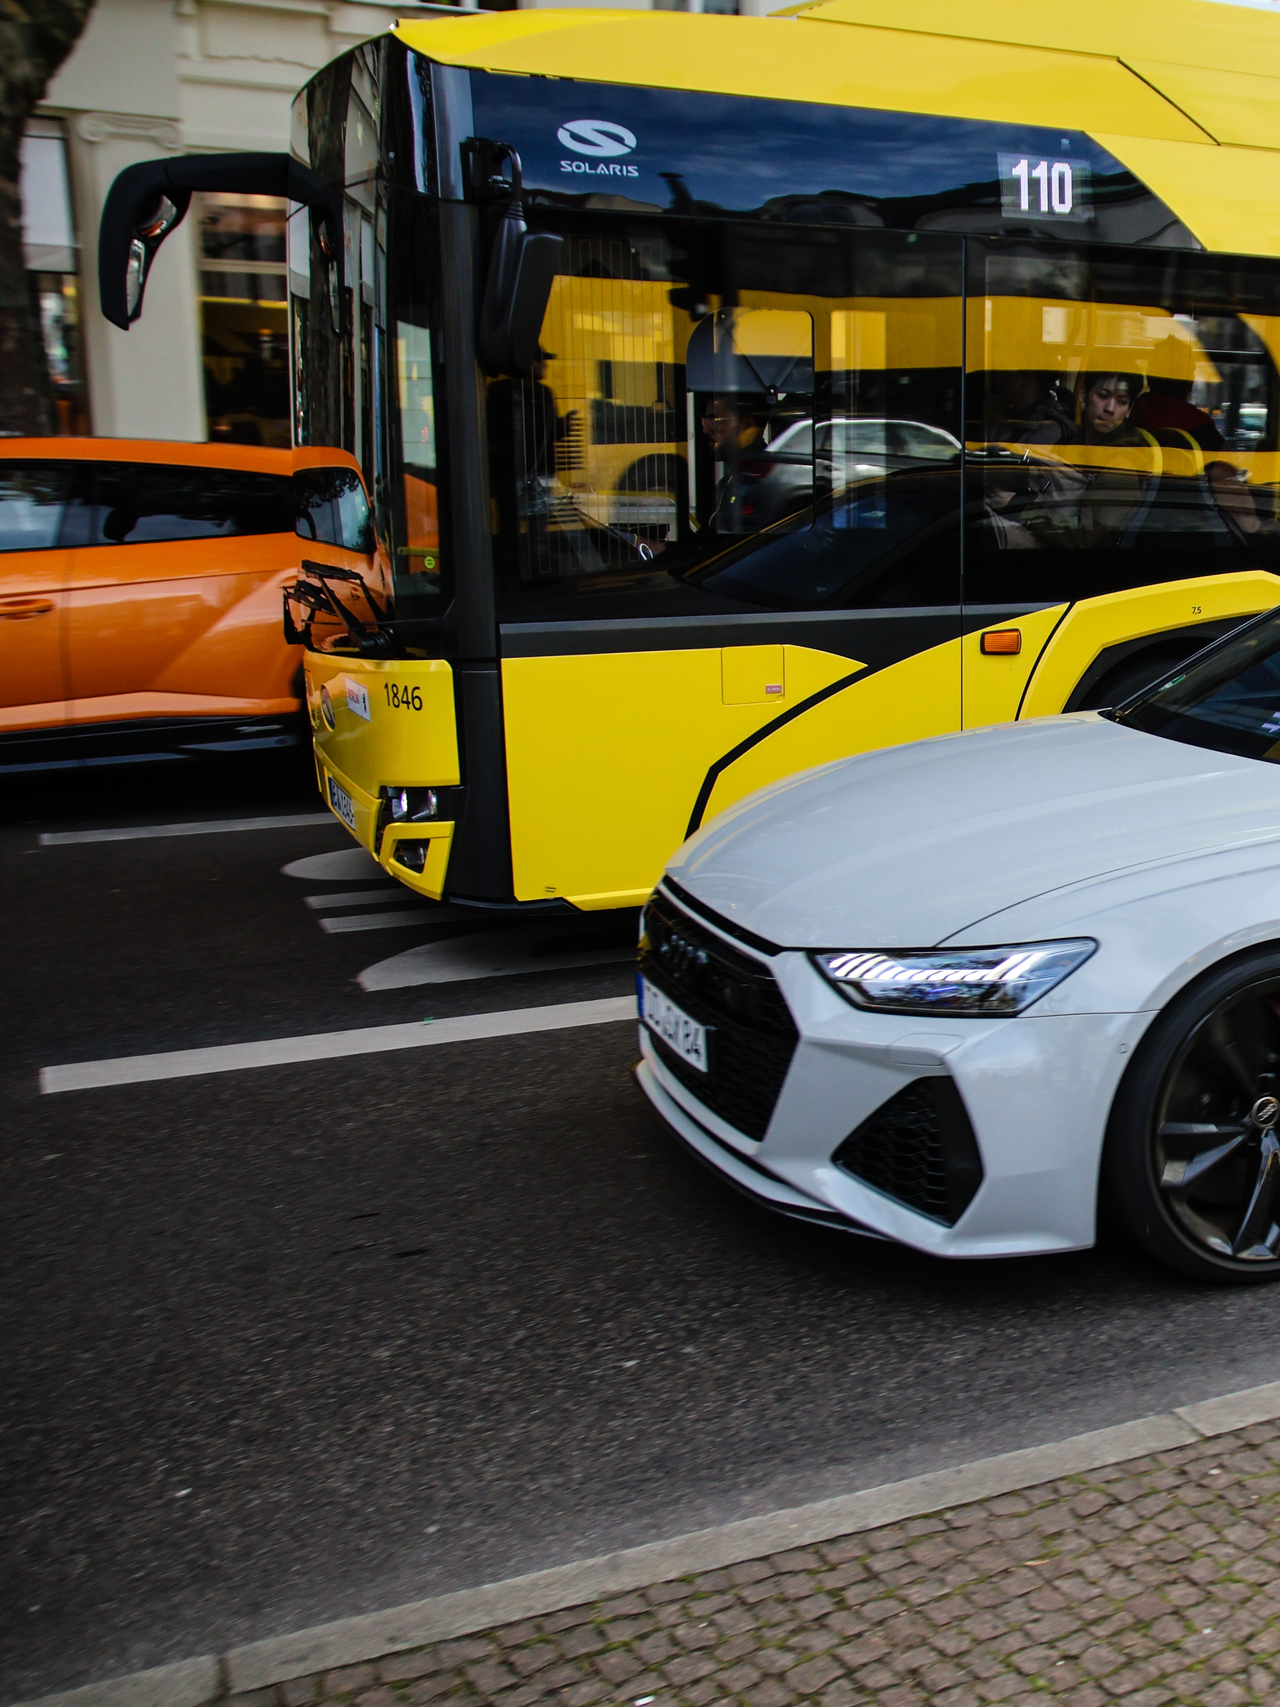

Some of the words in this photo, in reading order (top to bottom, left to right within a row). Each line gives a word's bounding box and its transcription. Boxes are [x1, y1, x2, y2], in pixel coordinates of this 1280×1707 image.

[560, 160, 639, 177] SOLARIS
[1012, 158, 1073, 214] 110
[1191, 605, 1202, 615] 7,5
[384, 682, 423, 711] 1846
